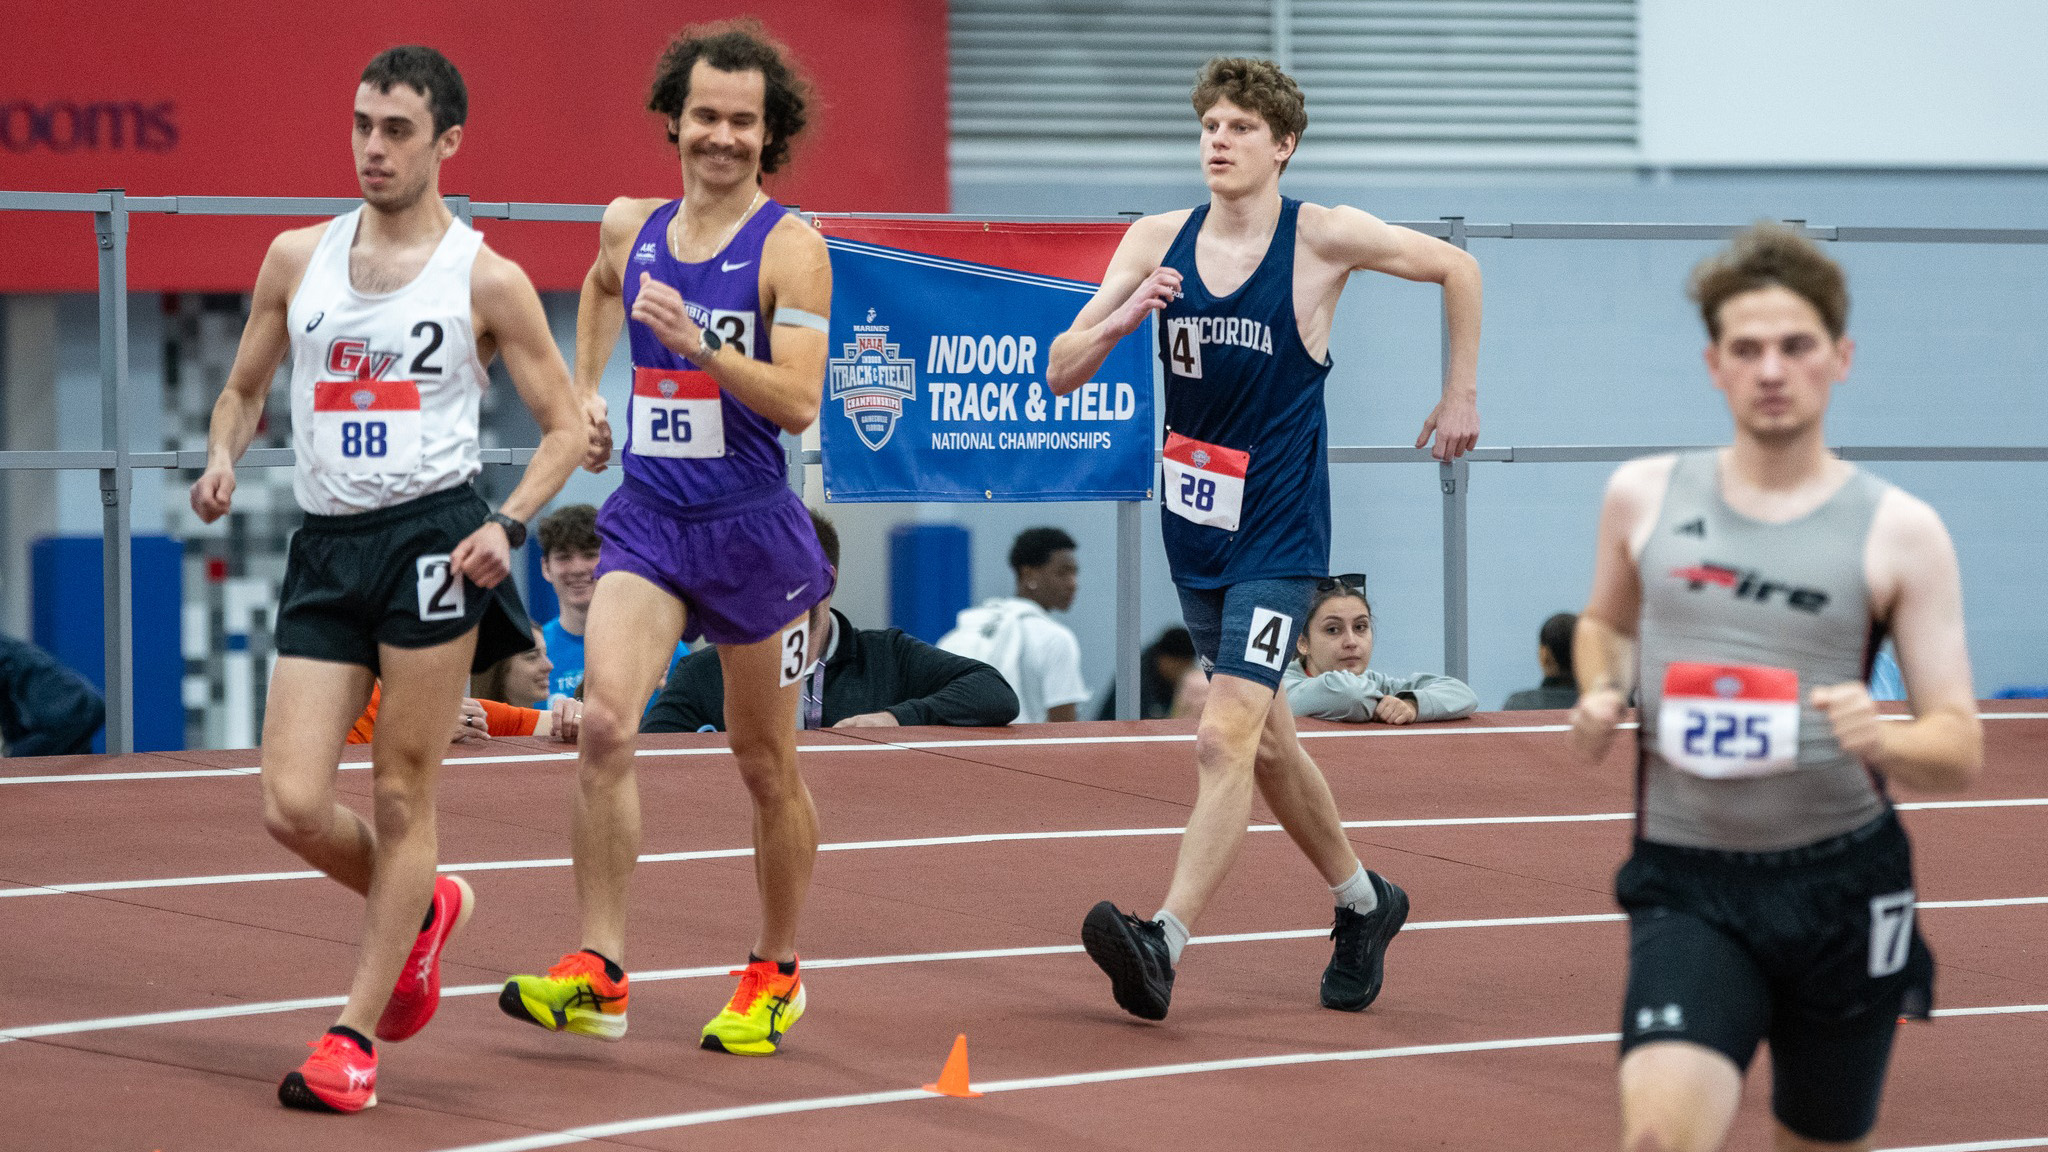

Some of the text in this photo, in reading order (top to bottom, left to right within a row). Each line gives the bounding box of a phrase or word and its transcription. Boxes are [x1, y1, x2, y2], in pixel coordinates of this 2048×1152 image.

[409, 320, 444, 375] 2
[716, 316, 746, 356] 3
[858, 338, 884, 354] NAIA
[926, 334, 1037, 375] INDOOR
[1172, 326, 1196, 374] 4
[326, 336, 403, 381] GV
[861, 355, 882, 364] INDOOR
[847, 395, 900, 410] CHAMPIONSHIPS
[928, 381, 1135, 422] TRACK & FIELD
[341, 421, 387, 458] 88
[650, 407, 692, 443] 26
[931, 431, 1111, 450] NATIONAL CHAMPIONSHIPS
[1180, 472, 1216, 513] 28
[423, 560, 458, 615] 2
[1670, 560, 1830, 616] Fire
[784, 629, 804, 679] 3
[1251, 615, 1283, 665] 4
[1684, 711, 1770, 759] 225
[1883, 905, 1905, 964] 7
